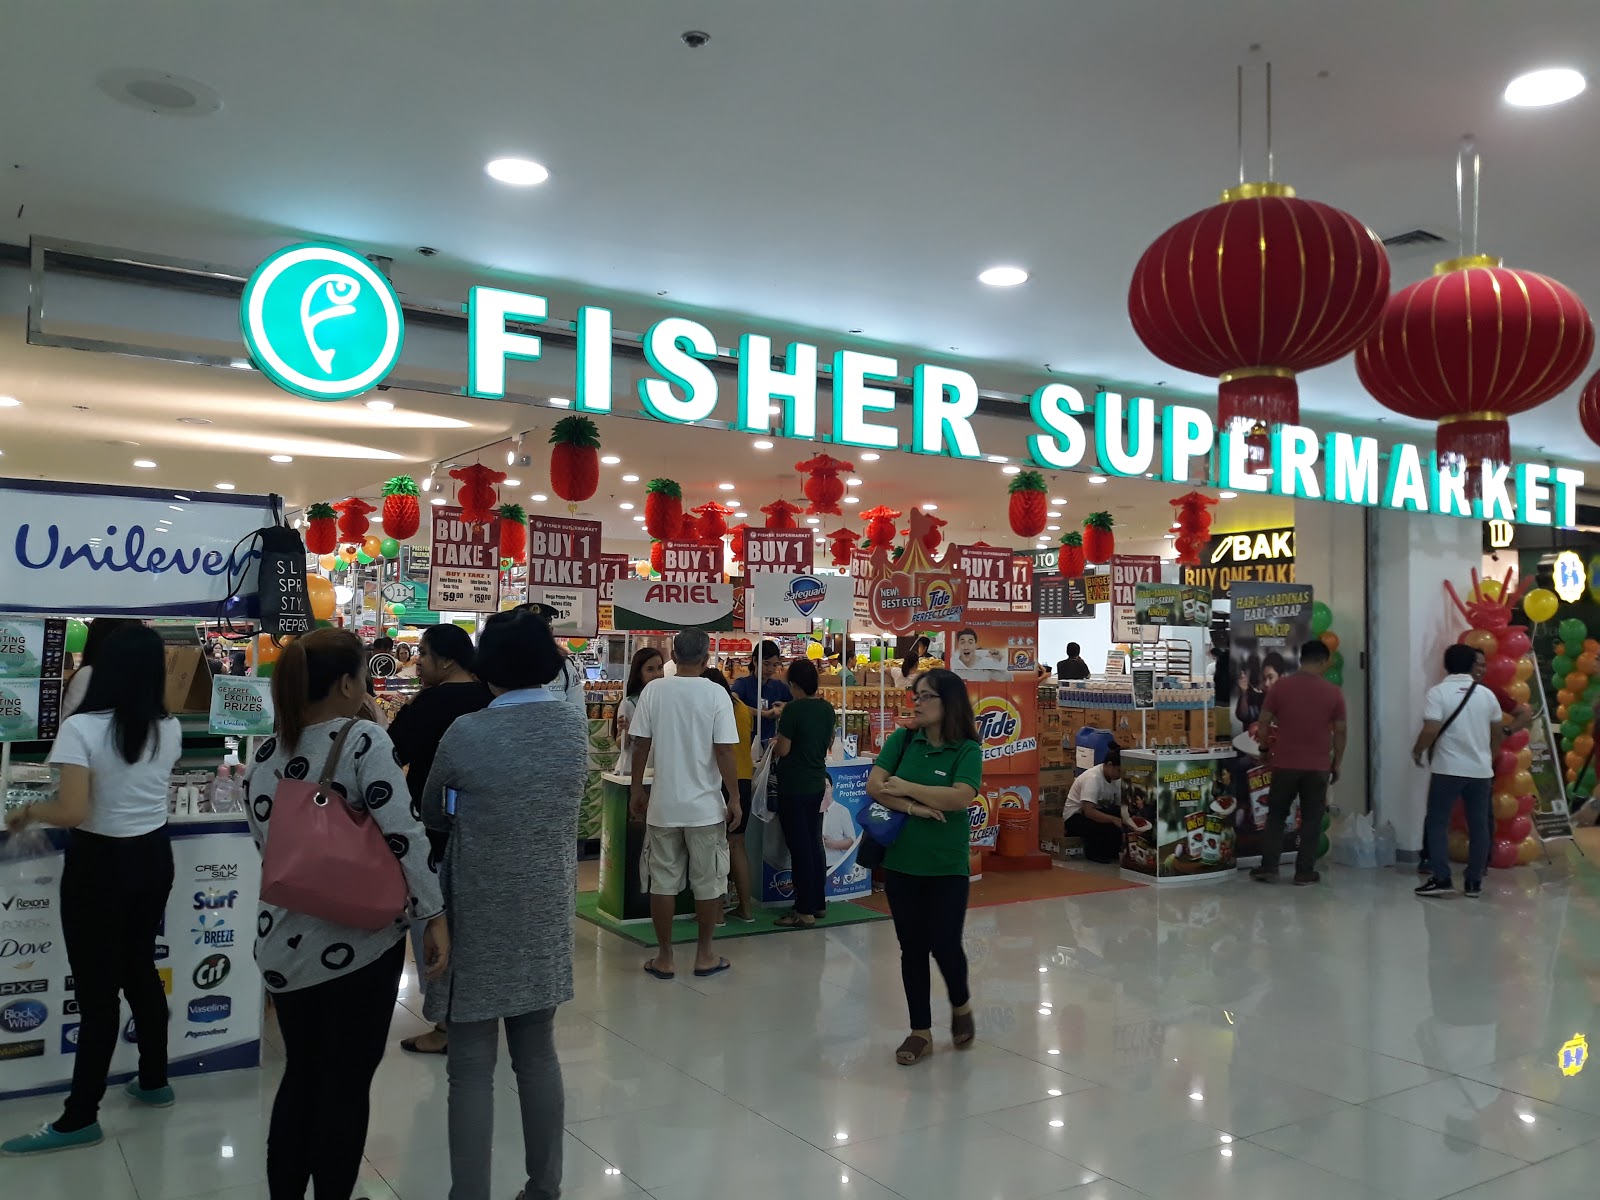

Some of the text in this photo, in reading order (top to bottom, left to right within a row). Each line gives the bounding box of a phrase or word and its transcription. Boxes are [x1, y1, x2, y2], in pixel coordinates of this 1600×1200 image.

[468, 285, 1585, 527] FISHER SUPERMARKET
[436, 519, 491, 543] BUY 1
[15, 524, 262, 576] Unilever
[533, 531, 590, 558] BUY 1
[748, 541, 803, 562] BUY 1
[1233, 531, 1296, 561] BAK
[435, 543, 483, 566] TAKE
[489, 547, 498, 567] 1
[666, 550, 715, 569] BUY 1
[532, 558, 583, 585] TAKE
[588, 562, 597, 585] 1
[996, 560, 1004, 578] 1
[1114, 566, 1144, 584] BUY
[1185, 567, 1217, 590] BUY
[1220, 566, 1253, 591] ONE
[396, 588, 407, 597] 11
[600, 582, 614, 598] KE
[645, 584, 719, 603] ARIEL
[784, 584, 827, 602] Safeguard
[880, 588, 899, 597] NEW!
[966, 579, 1010, 600] AKE 1
[1012, 584, 1023, 600] KE
[1114, 586, 1136, 603] TA
[881, 597, 922, 609] BEST EVER
[929, 590, 951, 610] Tide
[911, 605, 964, 622] PERFECT CLEAN
[224, 694, 263, 703] EXCITING
[224, 702, 262, 712] PRIZES
[975, 712, 1017, 740] Tide
[1004, 738, 1036, 755] CLEAN
[836, 780, 867, 790] Family Ger
[839, 789, 867, 797] Protectio
[967, 805, 987, 826] Tide
[195, 864, 238, 872] CREAM
[211, 870, 238, 878] SILK
[769, 878, 793, 889] Safegu
[16, 897, 50, 909] Rexona
[193, 889, 239, 910] Surf
[204, 929, 234, 944] BREEZE
[0, 938, 53, 957] Dove
[196, 958, 226, 986] Cif
[0, 980, 46, 994] AXE
[4, 1007, 35, 1020] Black
[189, 1003, 229, 1014] Vaseline
[8, 1018, 40, 1029] White
